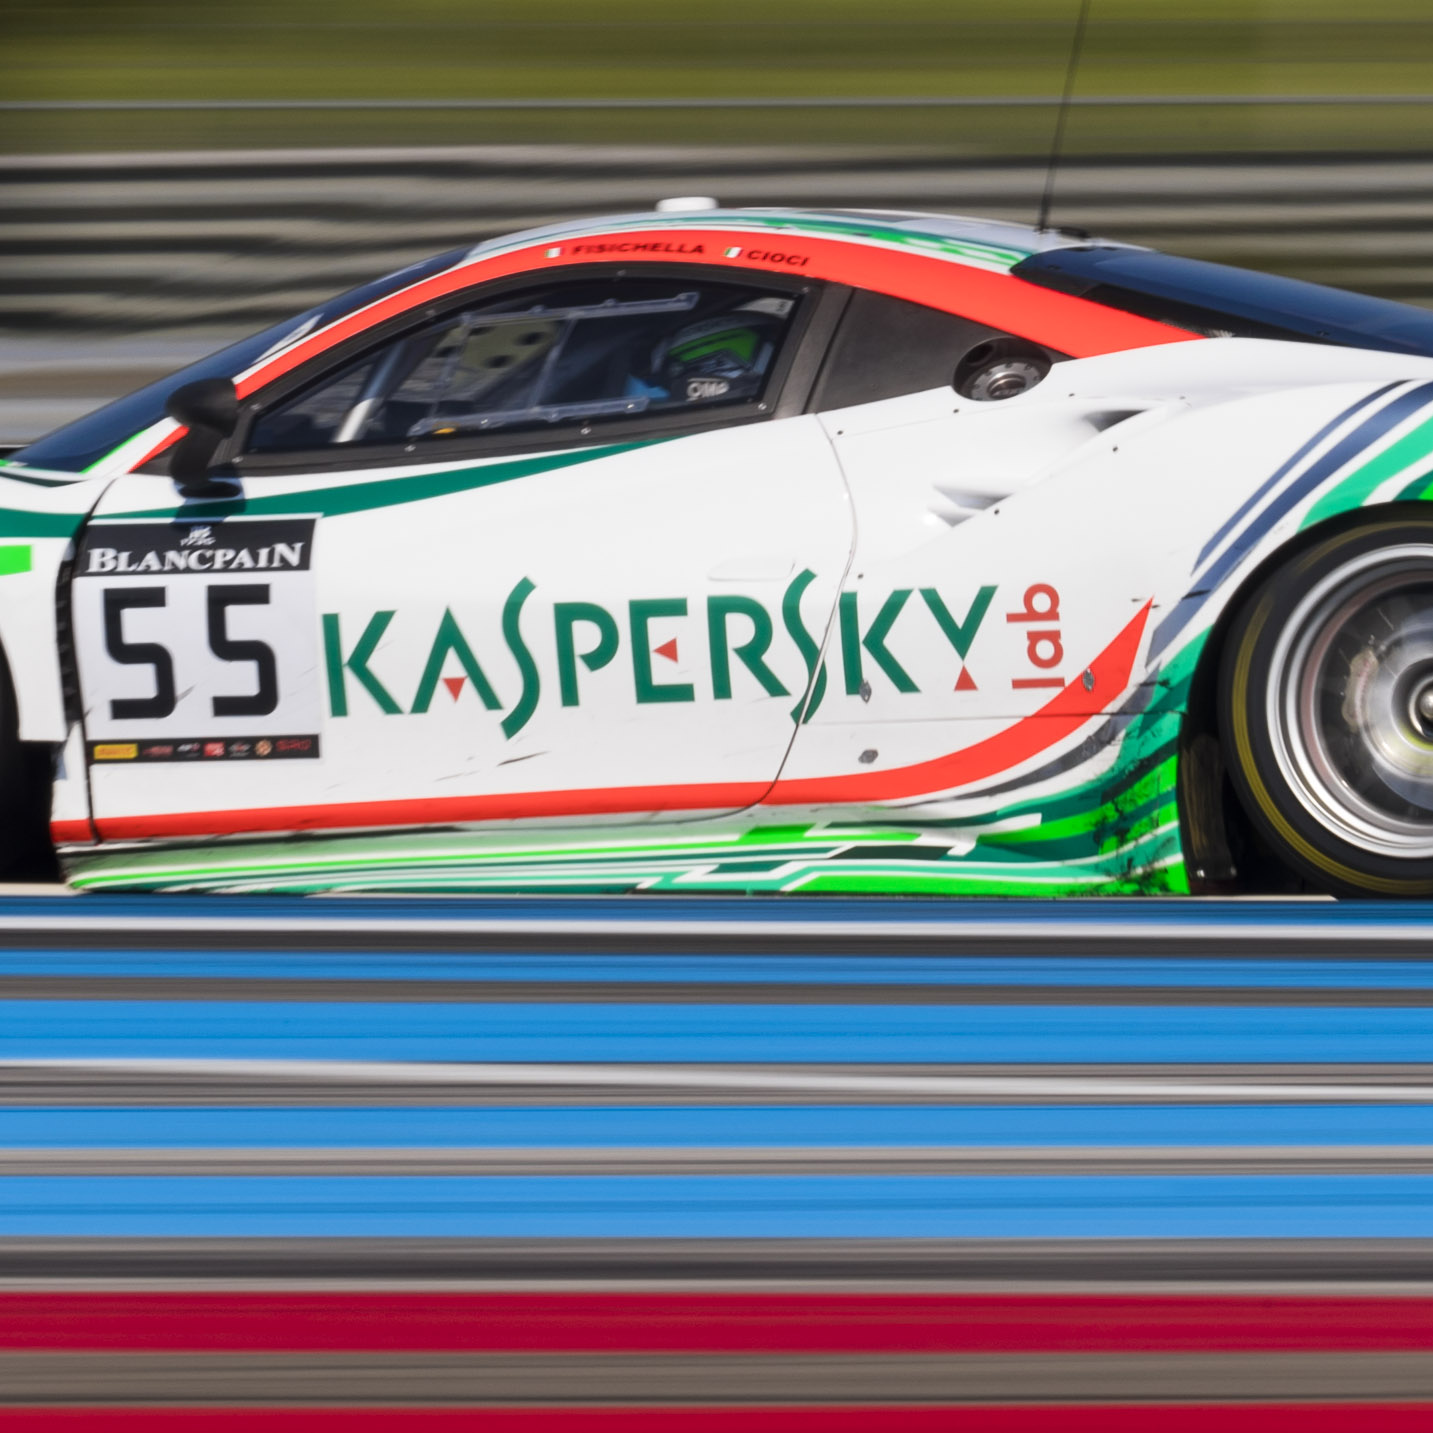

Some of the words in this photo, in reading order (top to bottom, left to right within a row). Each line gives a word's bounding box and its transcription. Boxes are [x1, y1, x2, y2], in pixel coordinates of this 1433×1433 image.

[572, 241, 705, 256] FISICHELLA
[746, 249, 809, 267] CIOCI
[85, 542, 306, 573] BLANCPAIN
[103, 583, 279, 720] 55
[321, 568, 999, 741] KASPERSKY
[1006, 582, 1066, 690] lab
